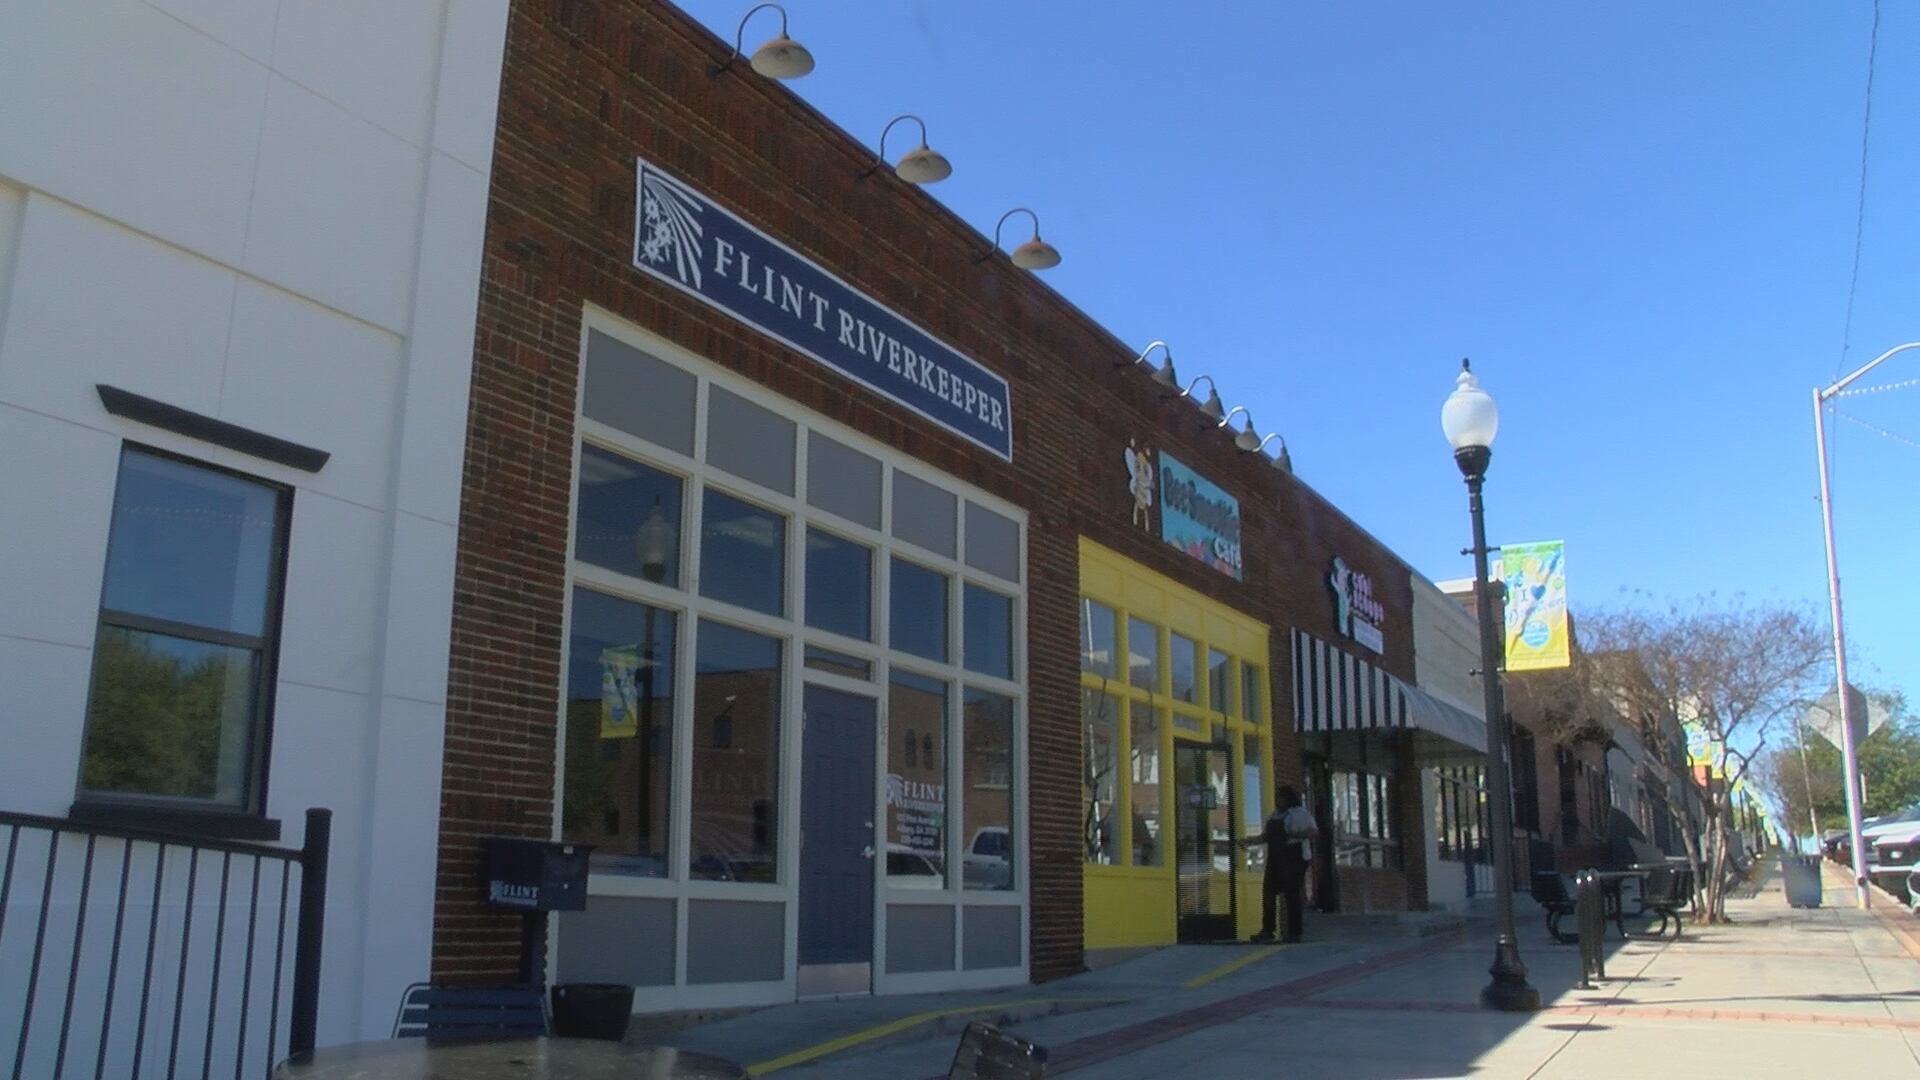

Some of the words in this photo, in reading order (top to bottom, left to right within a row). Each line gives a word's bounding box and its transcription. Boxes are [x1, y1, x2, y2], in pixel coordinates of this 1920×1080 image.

[713, 237, 830, 332] FLINT
[838, 307, 1004, 433] RIVERKEEPER
[904, 780, 945, 802] FLINT
[503, 884, 540, 898] FLINT
